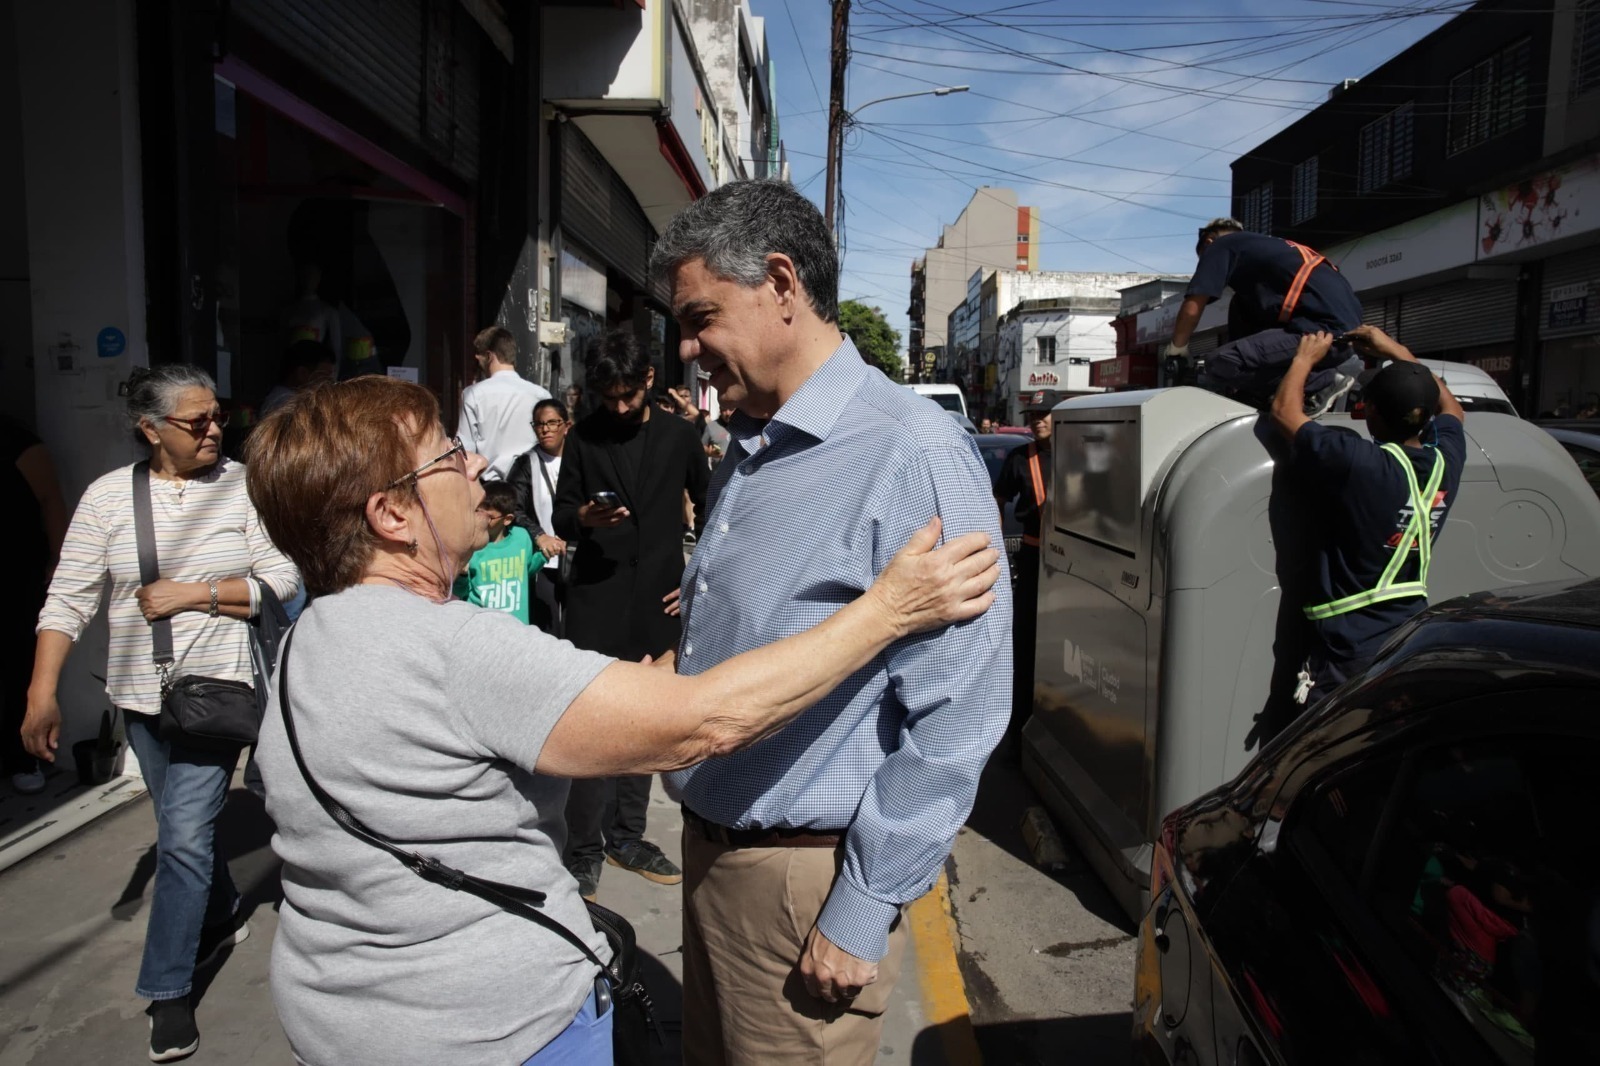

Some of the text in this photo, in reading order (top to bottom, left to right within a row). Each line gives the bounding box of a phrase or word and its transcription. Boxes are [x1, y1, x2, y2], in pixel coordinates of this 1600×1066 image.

[1467, 356, 1511, 372] AURIS
[1398, 509, 1444, 523] TS
[480, 549, 525, 585] I RUN
[477, 579, 521, 612] THIS!
